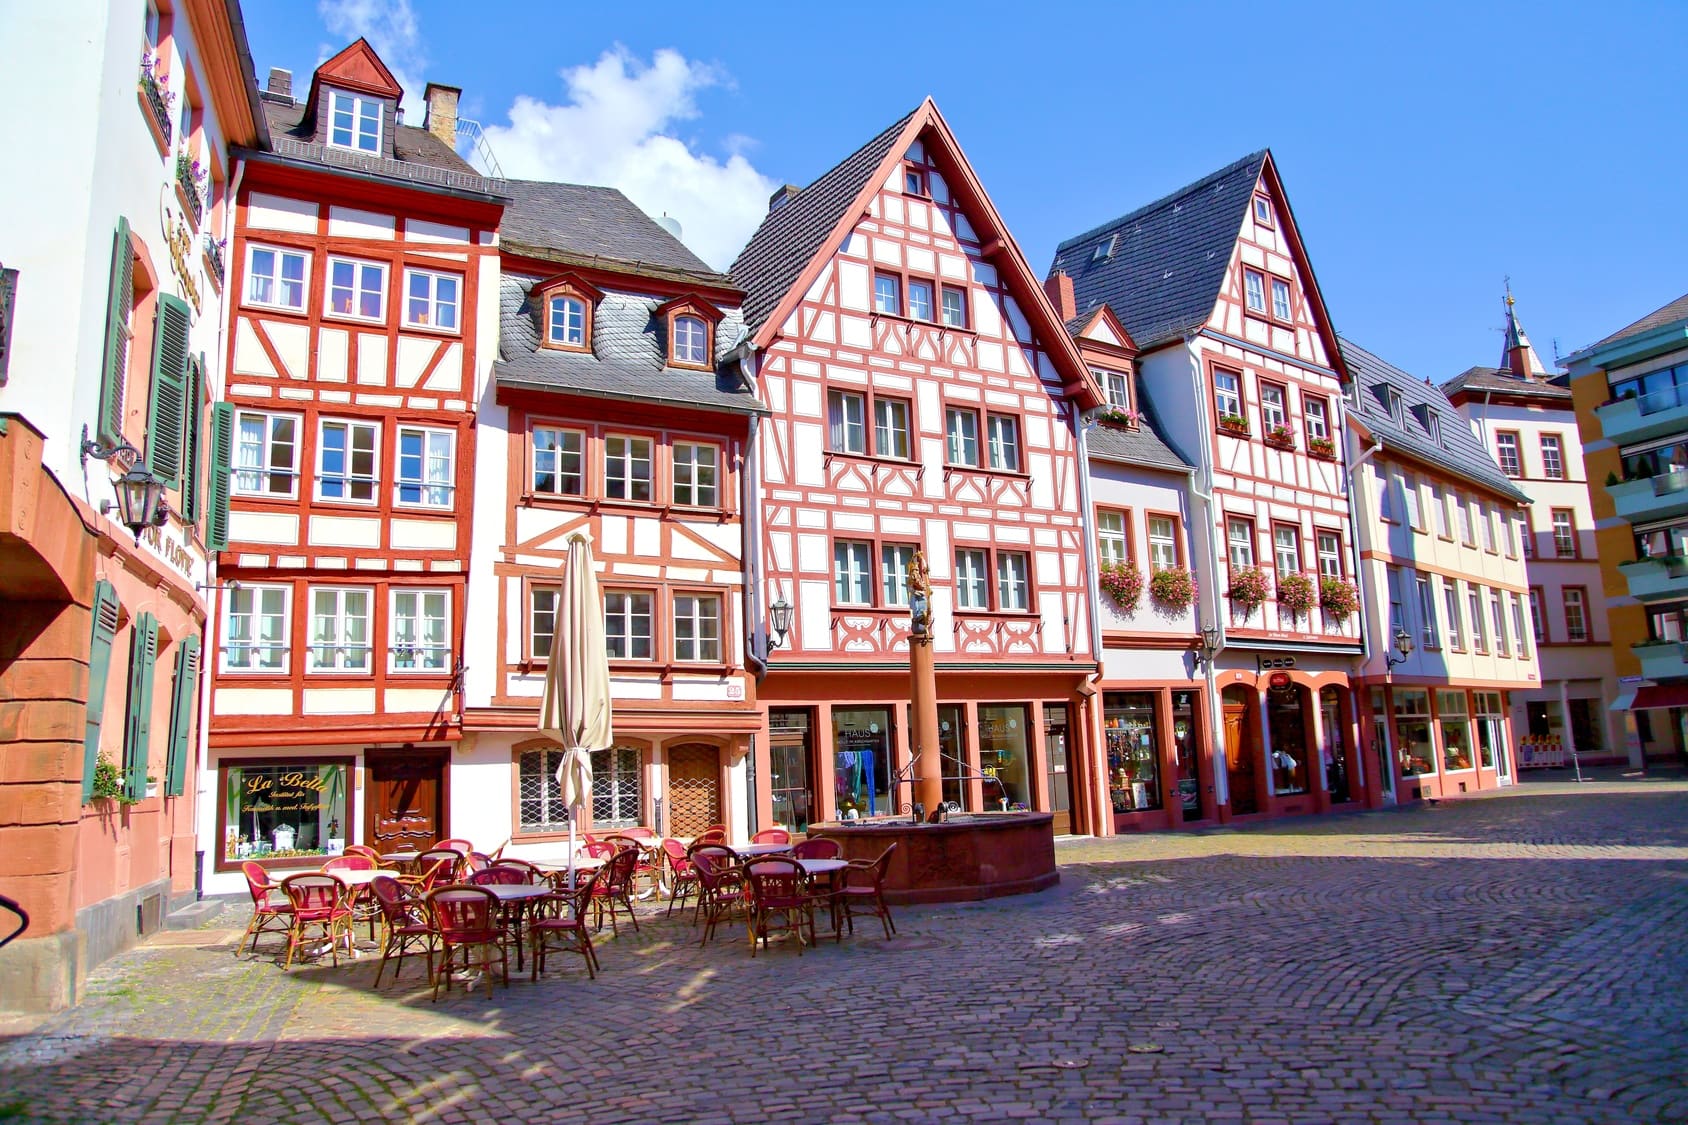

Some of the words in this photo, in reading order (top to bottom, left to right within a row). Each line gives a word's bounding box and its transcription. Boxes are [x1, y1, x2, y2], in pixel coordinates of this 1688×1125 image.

[844, 729, 871, 738] HAUS
[247, 775, 273, 795] La
[280, 772, 328, 792] Bella
